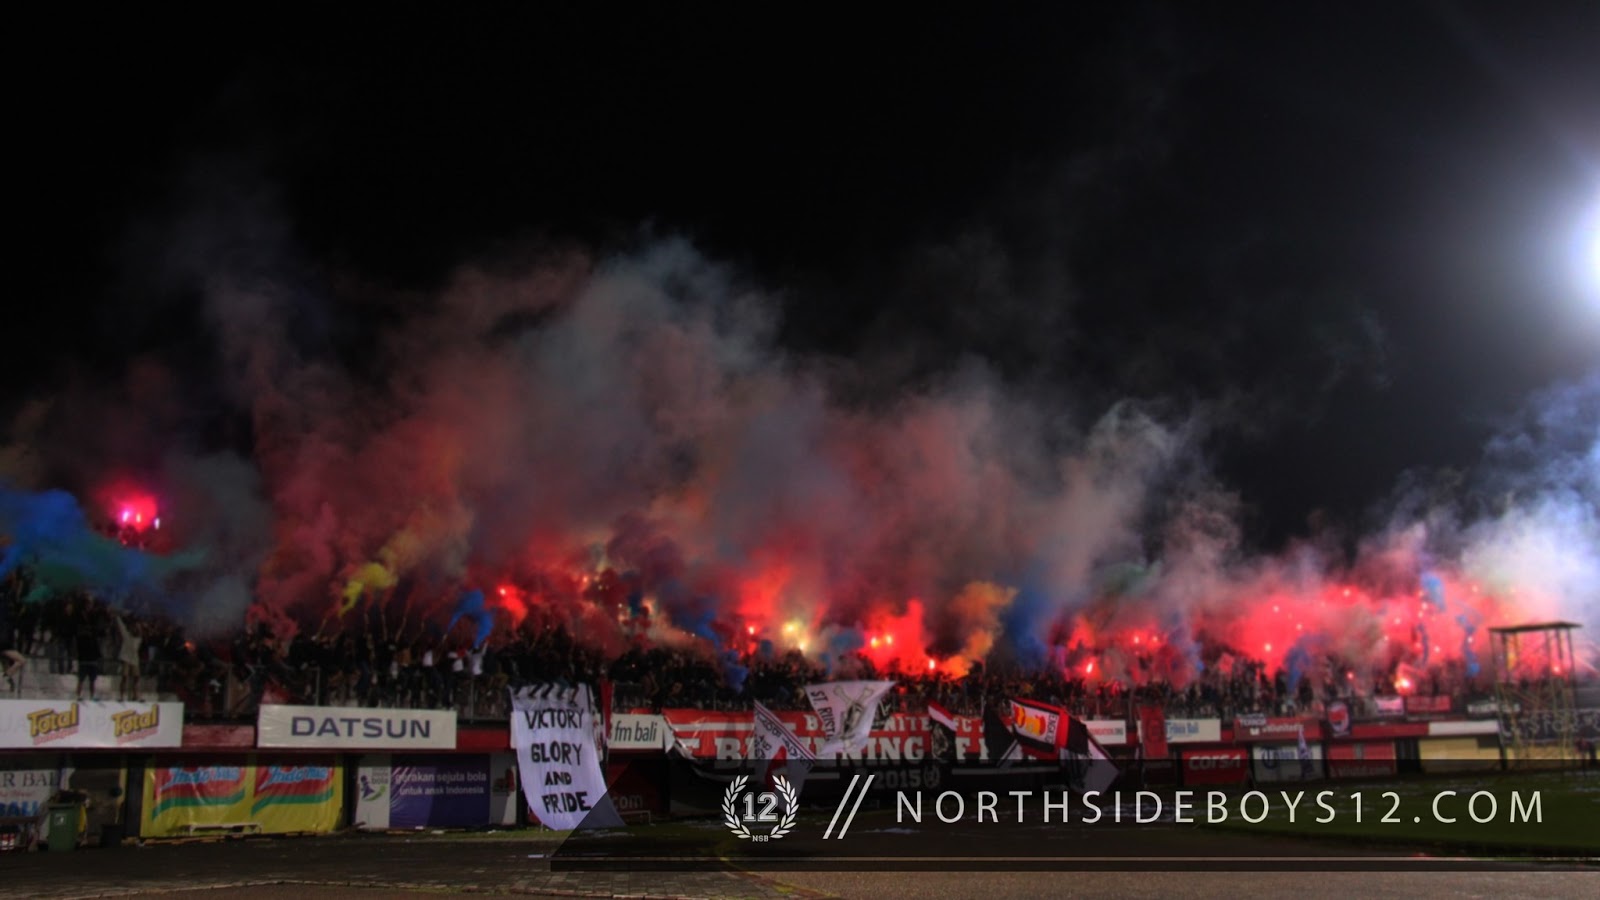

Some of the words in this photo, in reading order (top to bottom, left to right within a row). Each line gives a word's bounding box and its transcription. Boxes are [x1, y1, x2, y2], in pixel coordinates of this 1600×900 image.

[27, 703, 80, 737] Total
[111, 703, 160, 737] Total
[291, 716, 431, 739] DATSUN
[614, 720, 632, 742] fm
[634, 720, 658, 742] bali
[531, 741, 582, 766] GLORY
[395, 771, 435, 784] gerakan
[436, 772, 465, 784] sejuta
[467, 770, 487, 782] bola
[545, 771, 572, 786] AND
[875, 769, 921, 789] 2015
[542, 791, 592, 813] PRIDE
